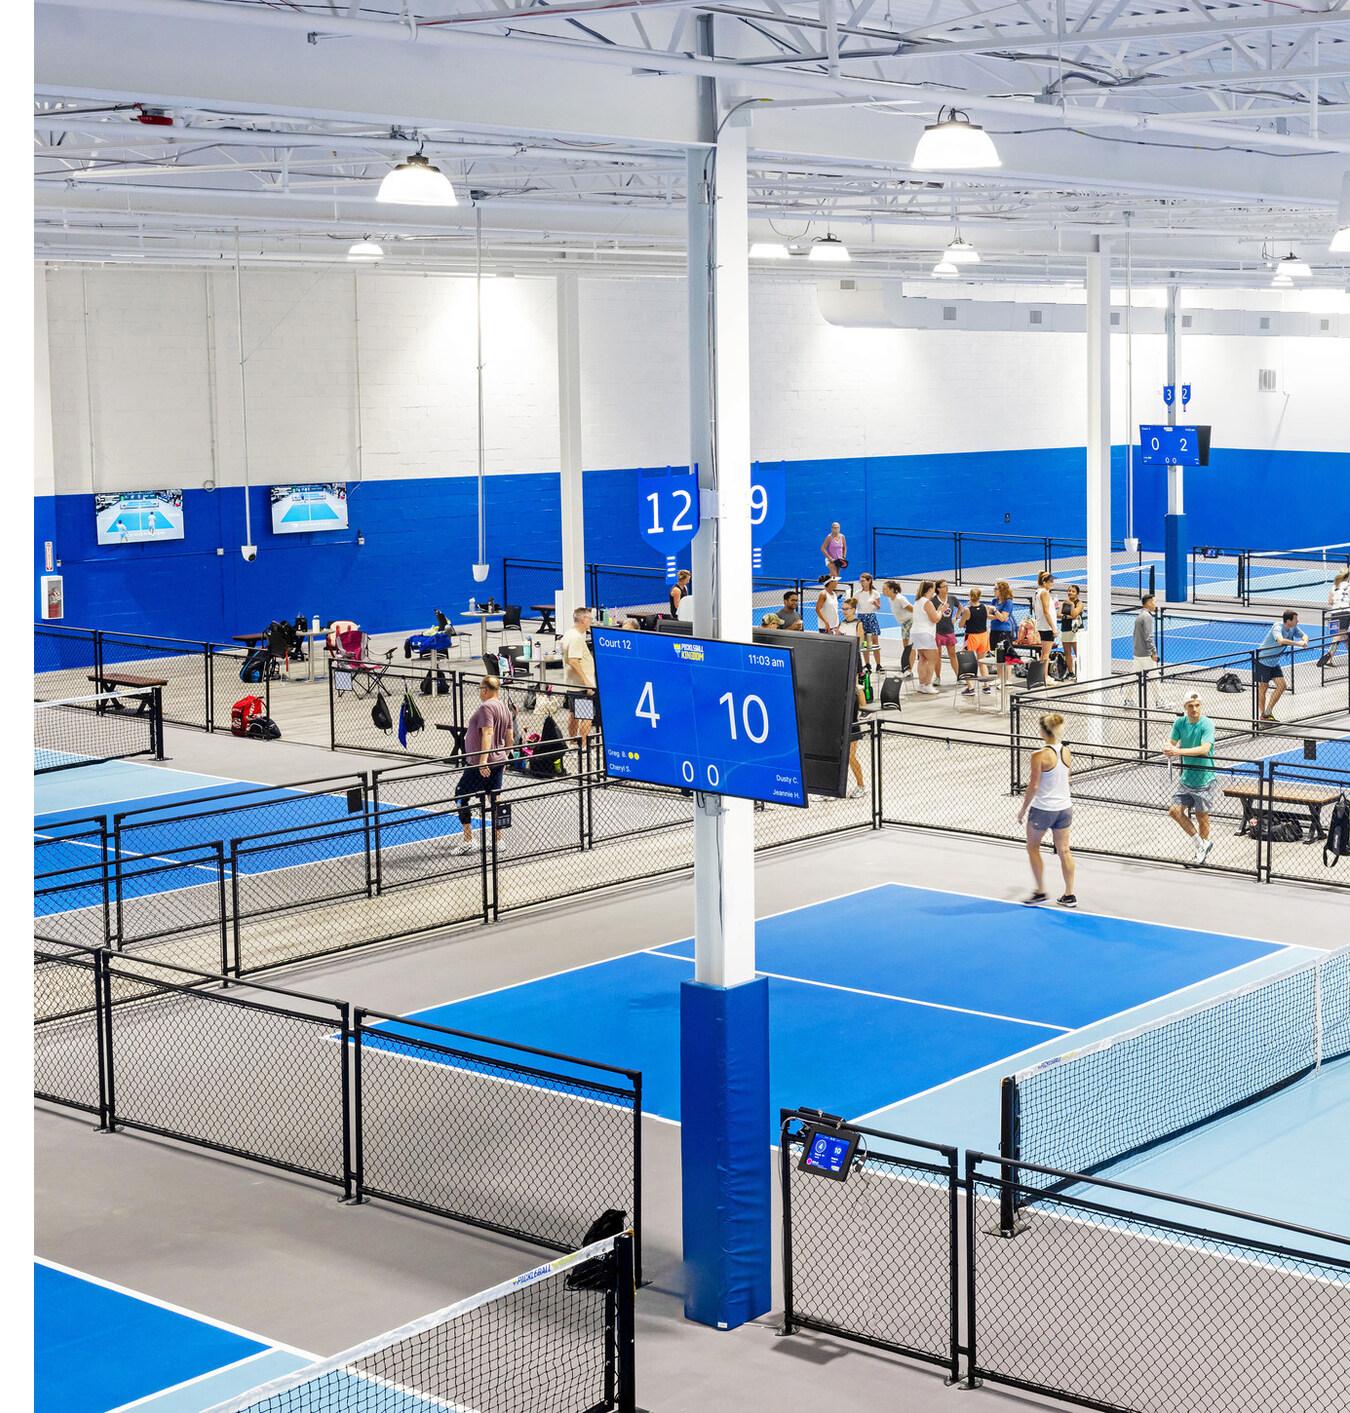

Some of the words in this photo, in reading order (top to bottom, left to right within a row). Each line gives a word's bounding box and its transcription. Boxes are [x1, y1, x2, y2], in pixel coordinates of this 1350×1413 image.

[1166, 389, 1172, 401] 3
[1182, 388, 1187, 400] 2
[1151, 437, 1159, 450] 0
[1179, 438, 1188, 451] 2
[646, 489, 693, 534] 12
[750, 484, 768, 525] 9
[598, 636, 621, 649] Court
[622, 639, 632, 650] 12
[748, 654, 770, 666] 11:03
[771, 659, 785, 668] am
[635, 681, 661, 729] 4
[719, 691, 769, 744] 10
[607, 749, 620, 758] Greg
[609, 763, 625, 772] Cheryl
[682, 760, 694, 783] 0
[707, 764, 719, 787] 0
[776, 774, 791, 784] Dusty
[772, 789, 793, 798] Jeannie
